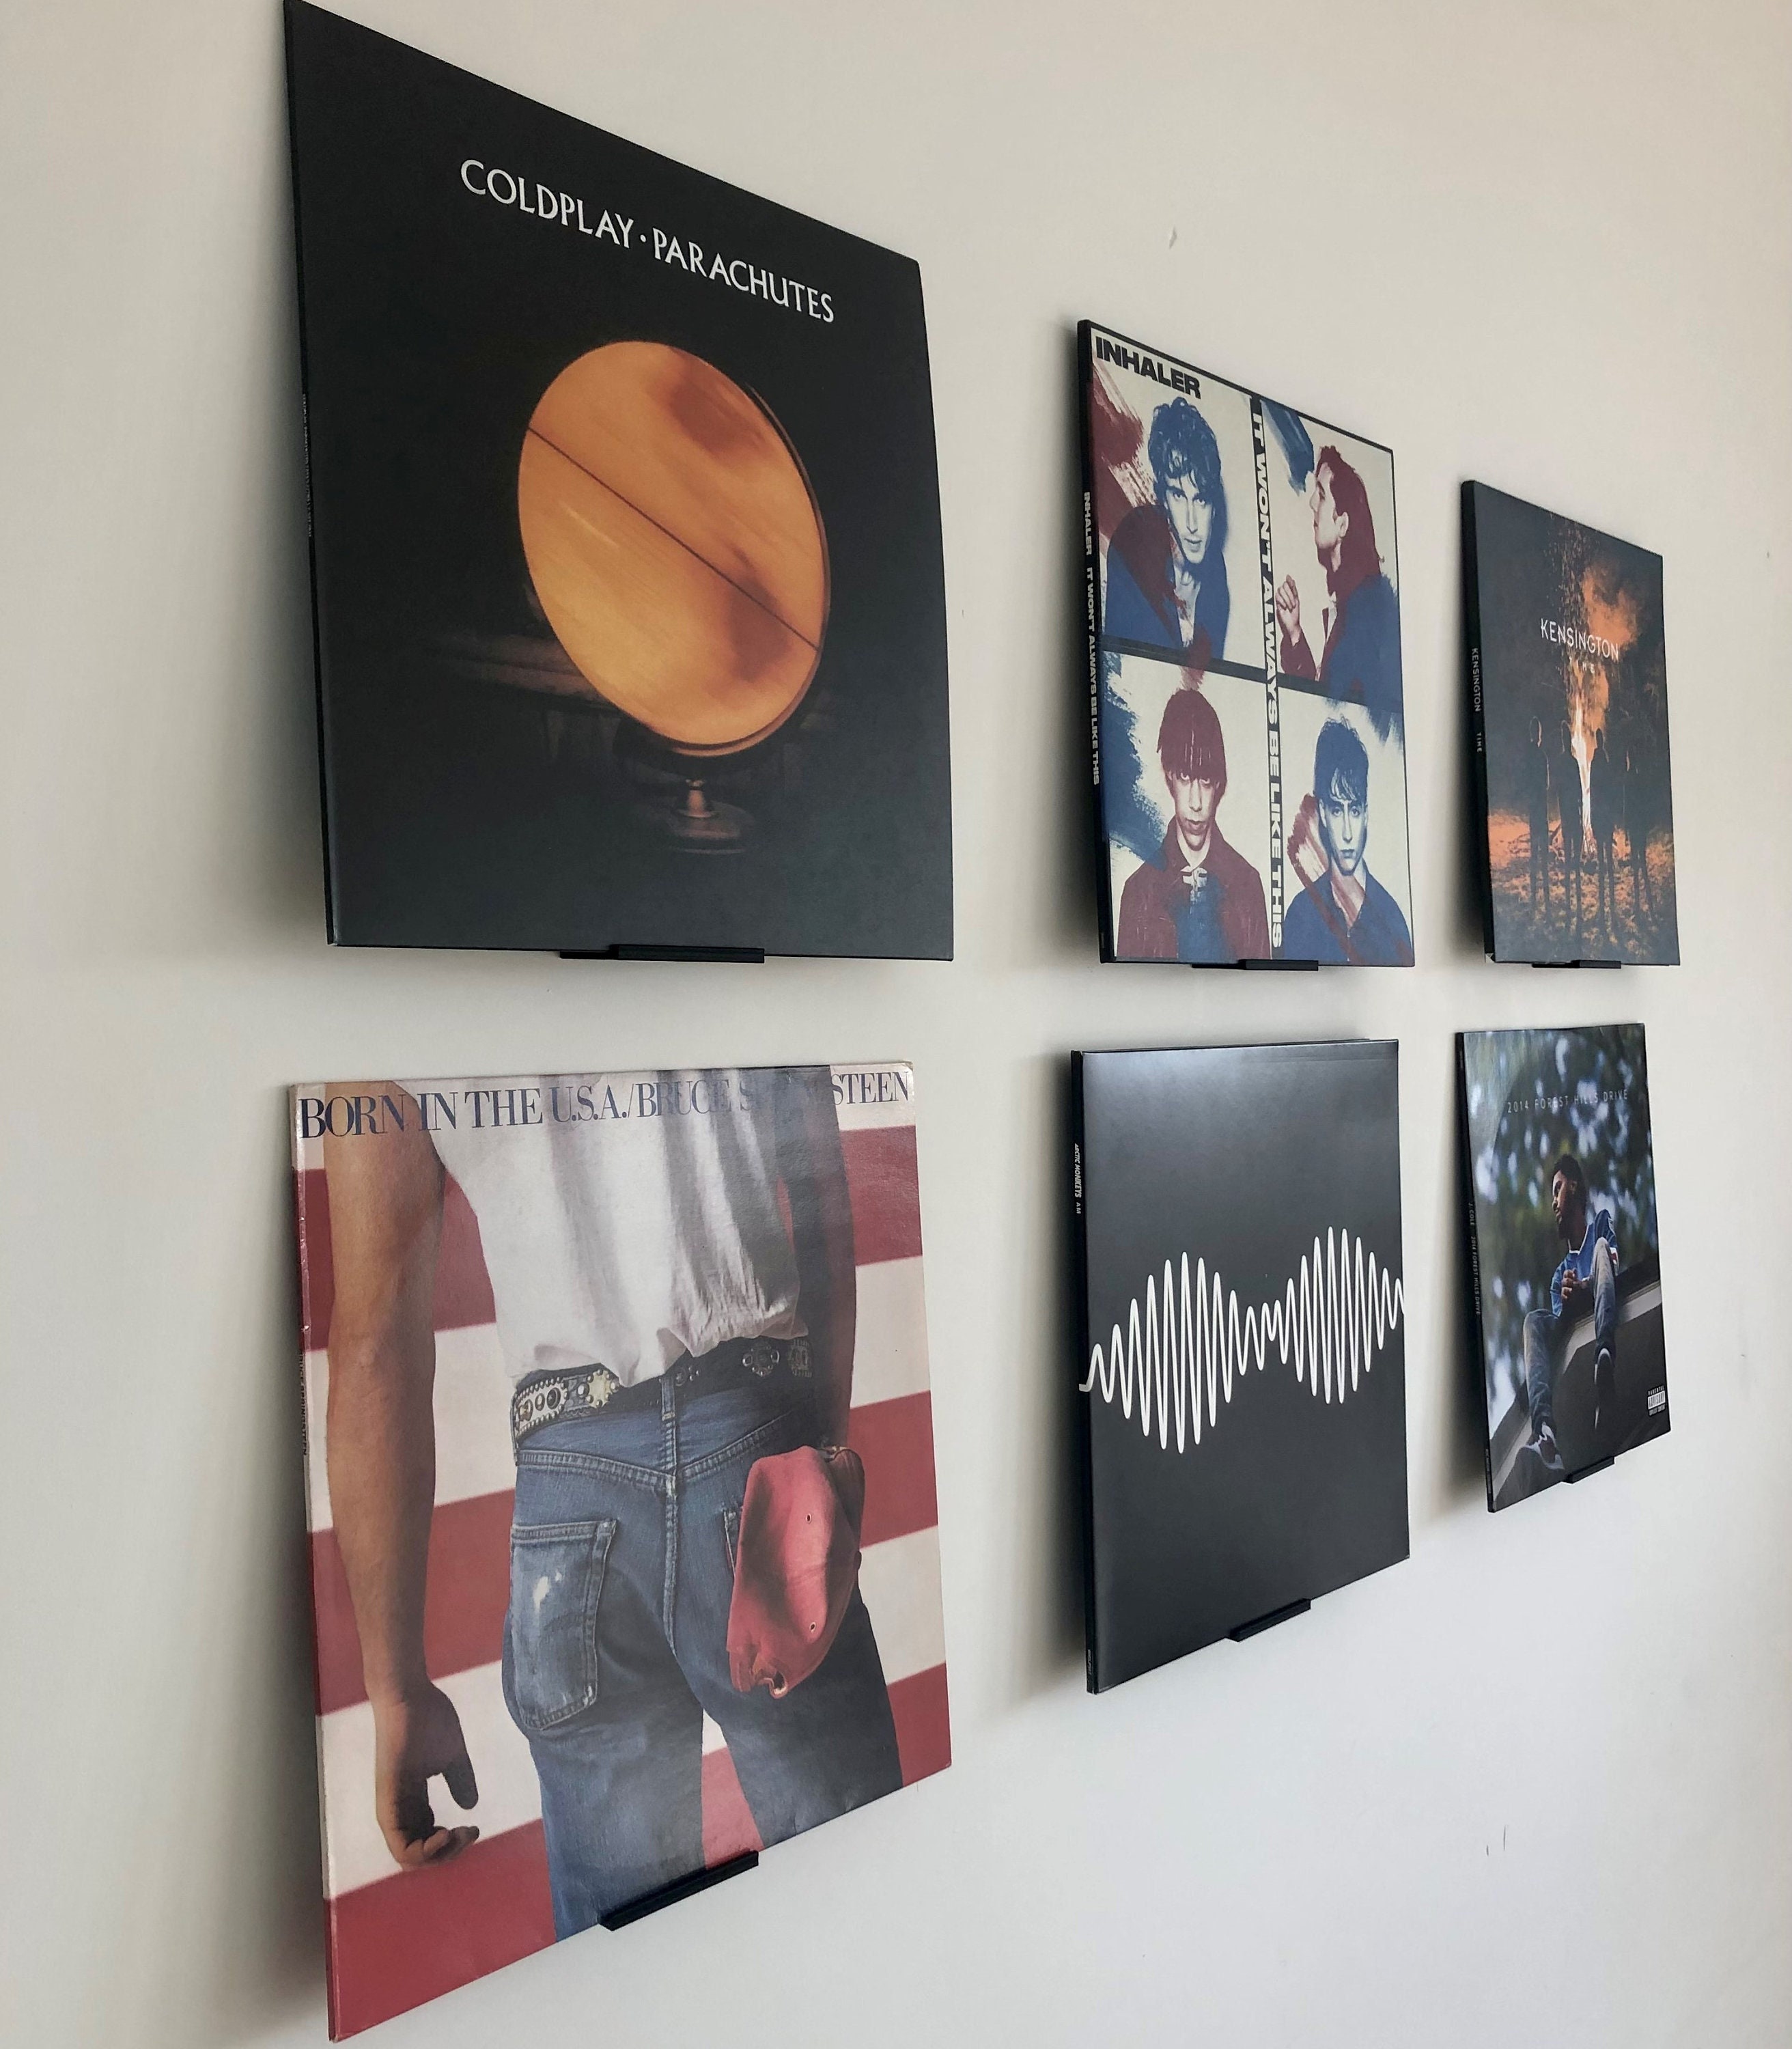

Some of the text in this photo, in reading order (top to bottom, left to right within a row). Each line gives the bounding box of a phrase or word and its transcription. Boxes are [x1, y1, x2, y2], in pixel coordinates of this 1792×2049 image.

[461, 159, 834, 322] COLDPLAY PARACHUTES
[1095, 336, 1201, 399] INHALER
[1084, 492, 1092, 555] INHALER
[1087, 567, 1093, 581] IT
[1541, 618, 1619, 662] KENSINGTON
[1091, 696, 1097, 716] BE
[1252, 413, 1282, 947] IT WON'T ALWAYS BE LIKE THIS
[1472, 648, 1481, 712] KENSINGTON
[298, 1093, 406, 1139] BORN
[417, 1091, 458, 1131] IN
[464, 1088, 544, 1128] THE
[1507, 1089, 1628, 1113] 2014 FOREST HILLS DRIVE
